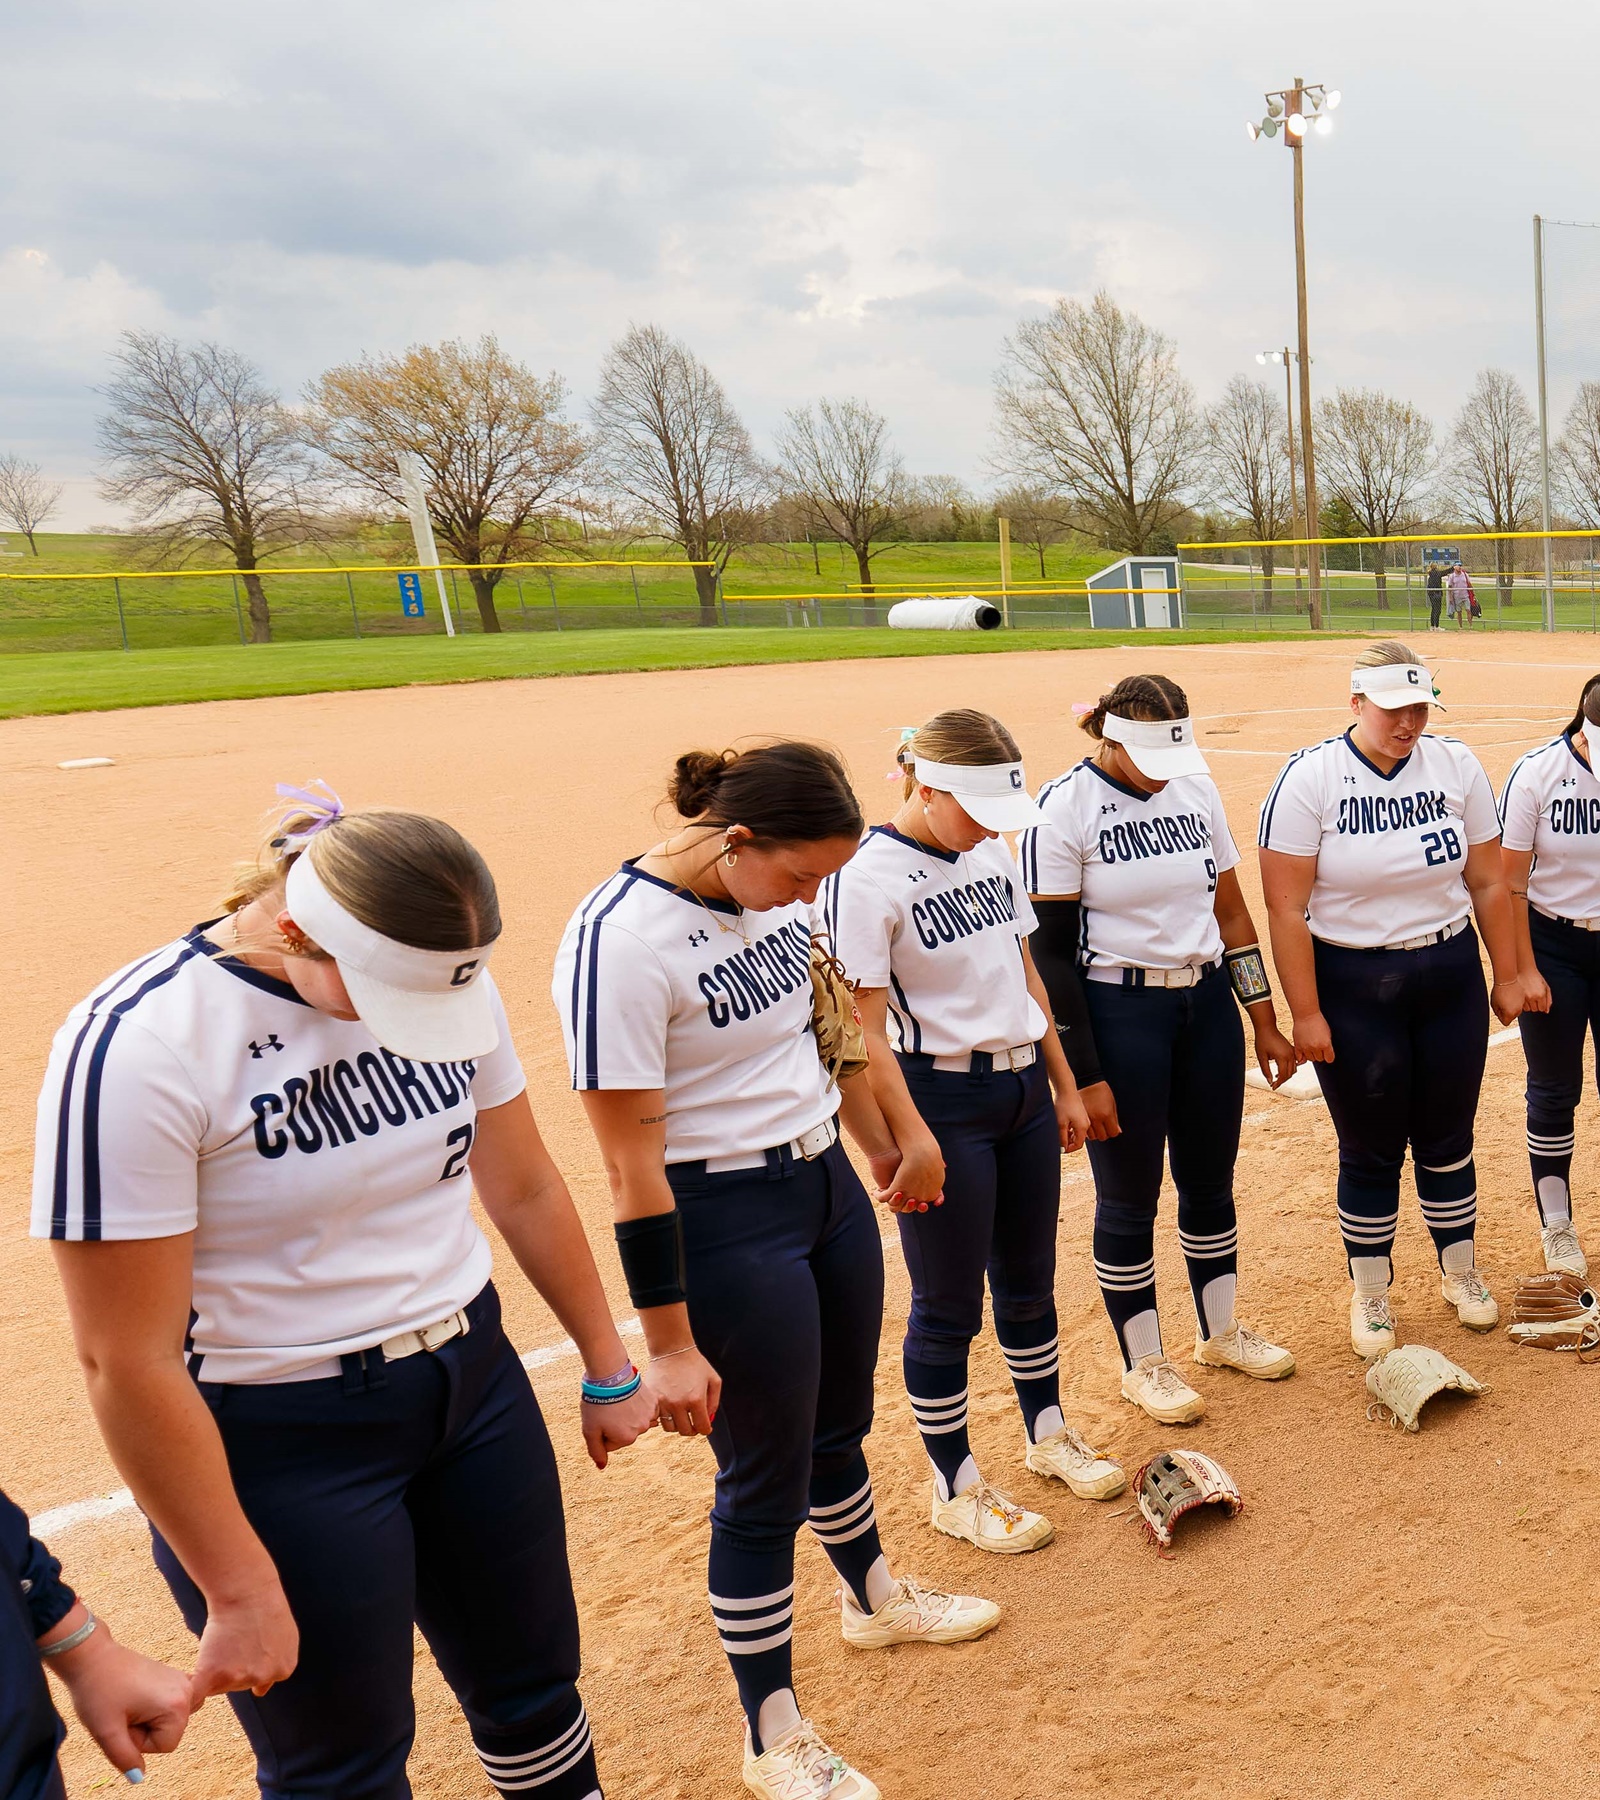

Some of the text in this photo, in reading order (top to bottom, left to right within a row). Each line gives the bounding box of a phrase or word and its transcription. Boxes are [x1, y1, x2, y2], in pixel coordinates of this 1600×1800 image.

[403, 576, 419, 614] 215
[1407, 669, 1419, 685] C
[1171, 726, 1183, 743] C
[1009, 769, 1023, 789] C
[1337, 790, 1449, 835] CONCORDIA
[1420, 827, 1462, 867] 28
[1204, 858, 1217, 892] 9
[450, 959, 479, 986] C
[1188, 1457, 1211, 1482] A2000
